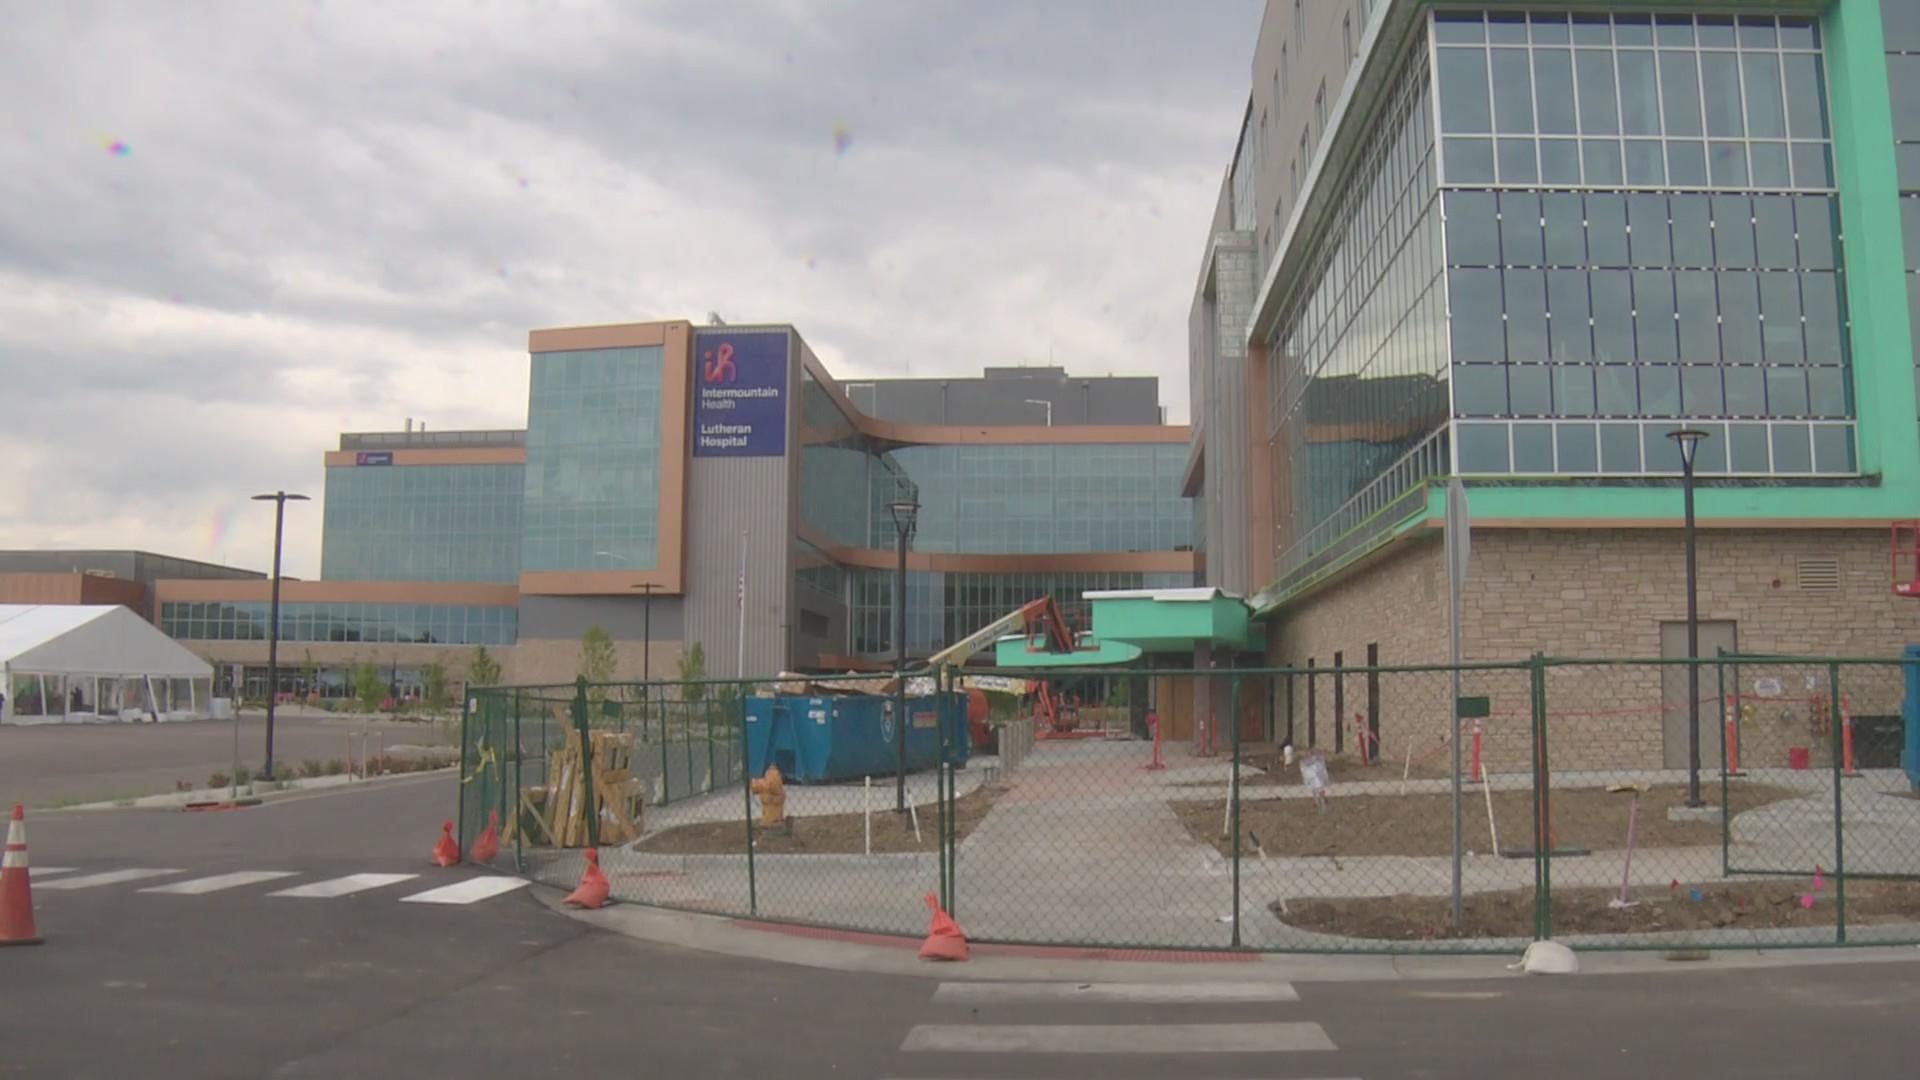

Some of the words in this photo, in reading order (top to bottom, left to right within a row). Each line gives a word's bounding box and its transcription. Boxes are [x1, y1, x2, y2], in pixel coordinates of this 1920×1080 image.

[702, 387, 778, 398] Intermountain
[702, 399, 735, 409] Health
[701, 424, 751, 434] Lutheran
[701, 436, 747, 448] Hospital
